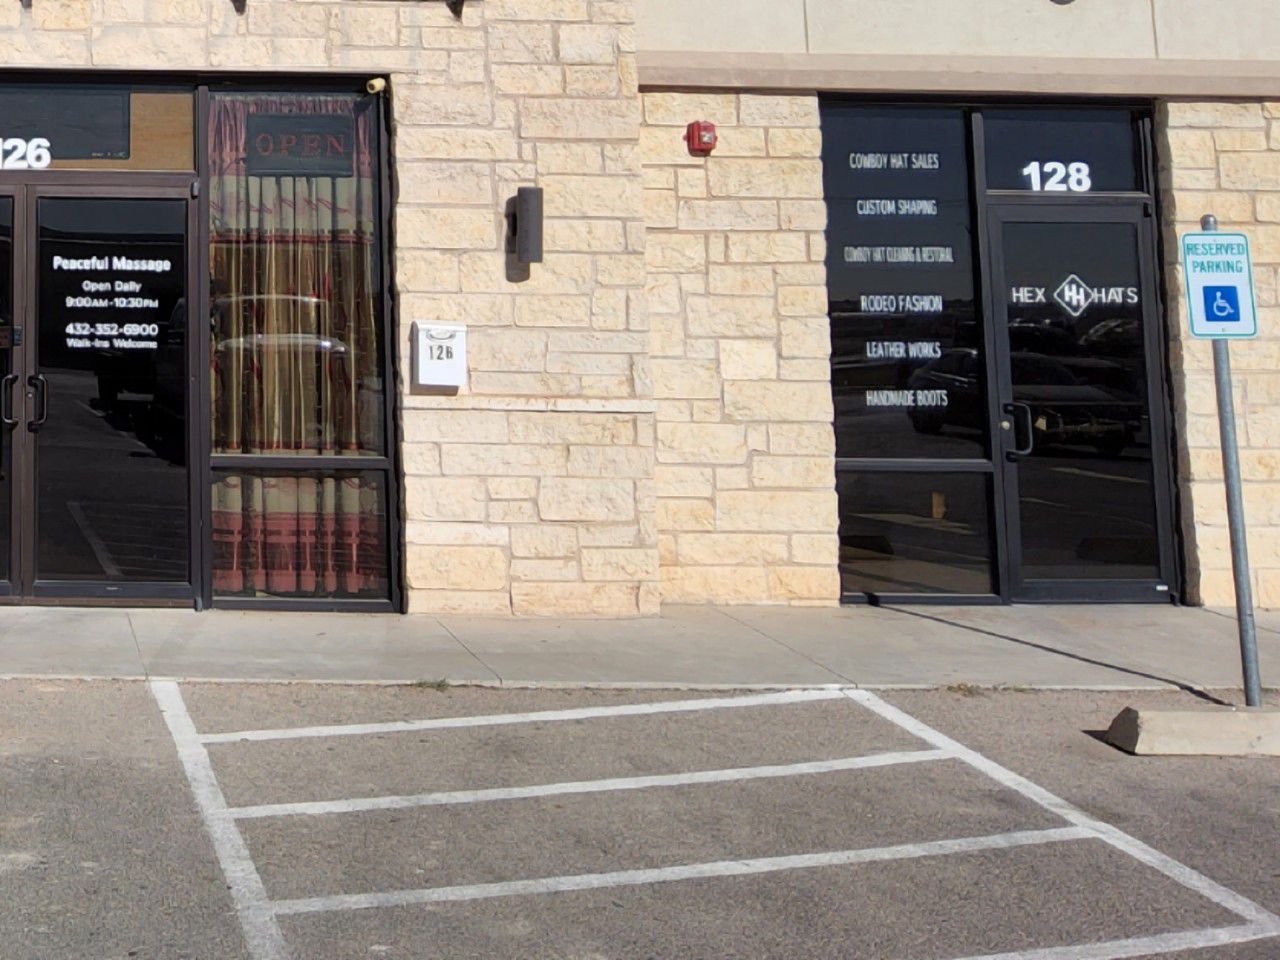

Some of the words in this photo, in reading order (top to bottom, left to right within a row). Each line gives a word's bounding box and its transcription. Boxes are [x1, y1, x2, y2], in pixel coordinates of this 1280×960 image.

[255, 132, 346, 157] OPEN
[849, 153, 888, 169] COWBOY
[890, 153, 909, 169] HAT
[911, 153, 939, 169] SALES
[1022, 161, 1092, 192] 128
[856, 199, 896, 215] CUSTOM
[898, 199, 938, 215] SHAPING
[1186, 243, 1246, 256] RESERVED
[53, 255, 109, 270] Peaceful
[112, 256, 172, 272] Massage
[1192, 260, 1243, 273] PARKING
[81, 280, 112, 292] Open
[114, 281, 142, 293] Daily
[861, 295, 897, 312] RODEO
[899, 295, 943, 312] FASHION
[1011, 287, 1047, 303] HEX
[1093, 287, 1139, 304] HATS
[65, 323, 159, 336] 432-352-6900
[112, 338, 158, 349] Welcome
[866, 341, 907, 358] LEATHER
[907, 341, 942, 358] WORKS
[865, 390, 916, 407] HANDMADE
[916, 390, 949, 407] BOOTS
